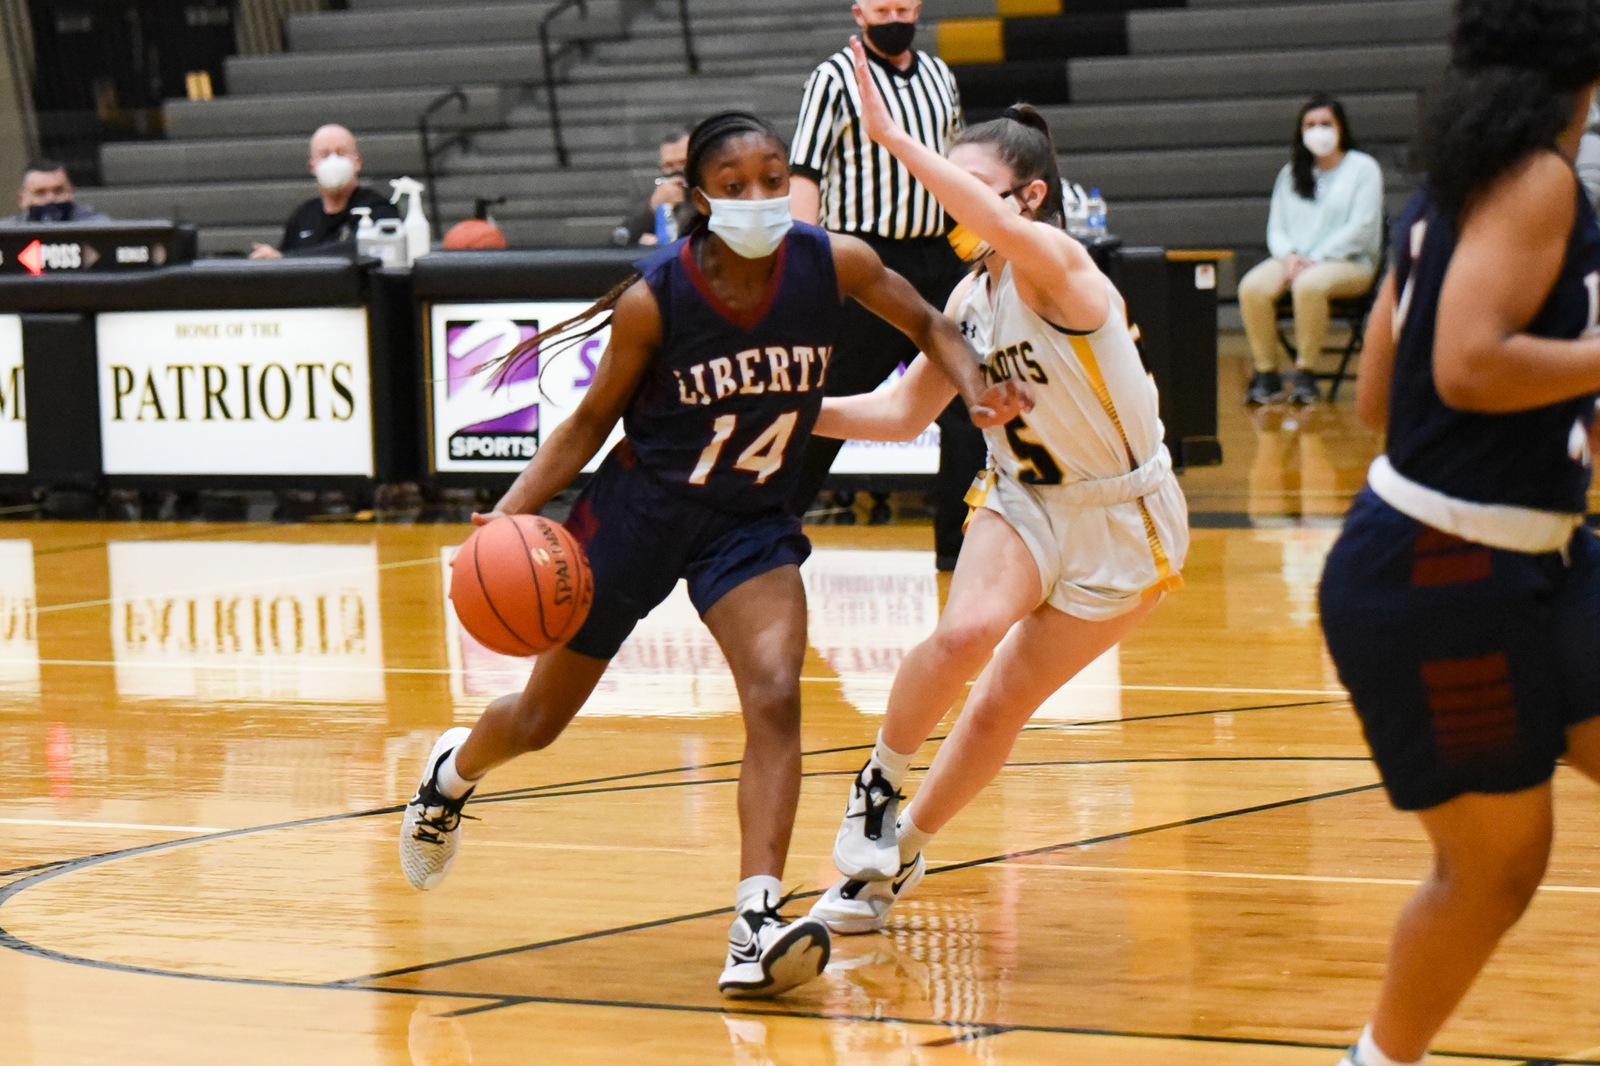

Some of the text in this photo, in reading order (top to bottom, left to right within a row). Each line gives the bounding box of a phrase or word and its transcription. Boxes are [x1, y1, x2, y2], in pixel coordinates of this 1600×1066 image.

[175, 323, 279, 338] HOME OF THE
[109, 362, 355, 422] PATRIOTS
[673, 345, 833, 406] LIBERTY
[450, 435, 538, 457] SPORTS
[688, 410, 798, 485] 14
[1003, 415, 1063, 485] 5
